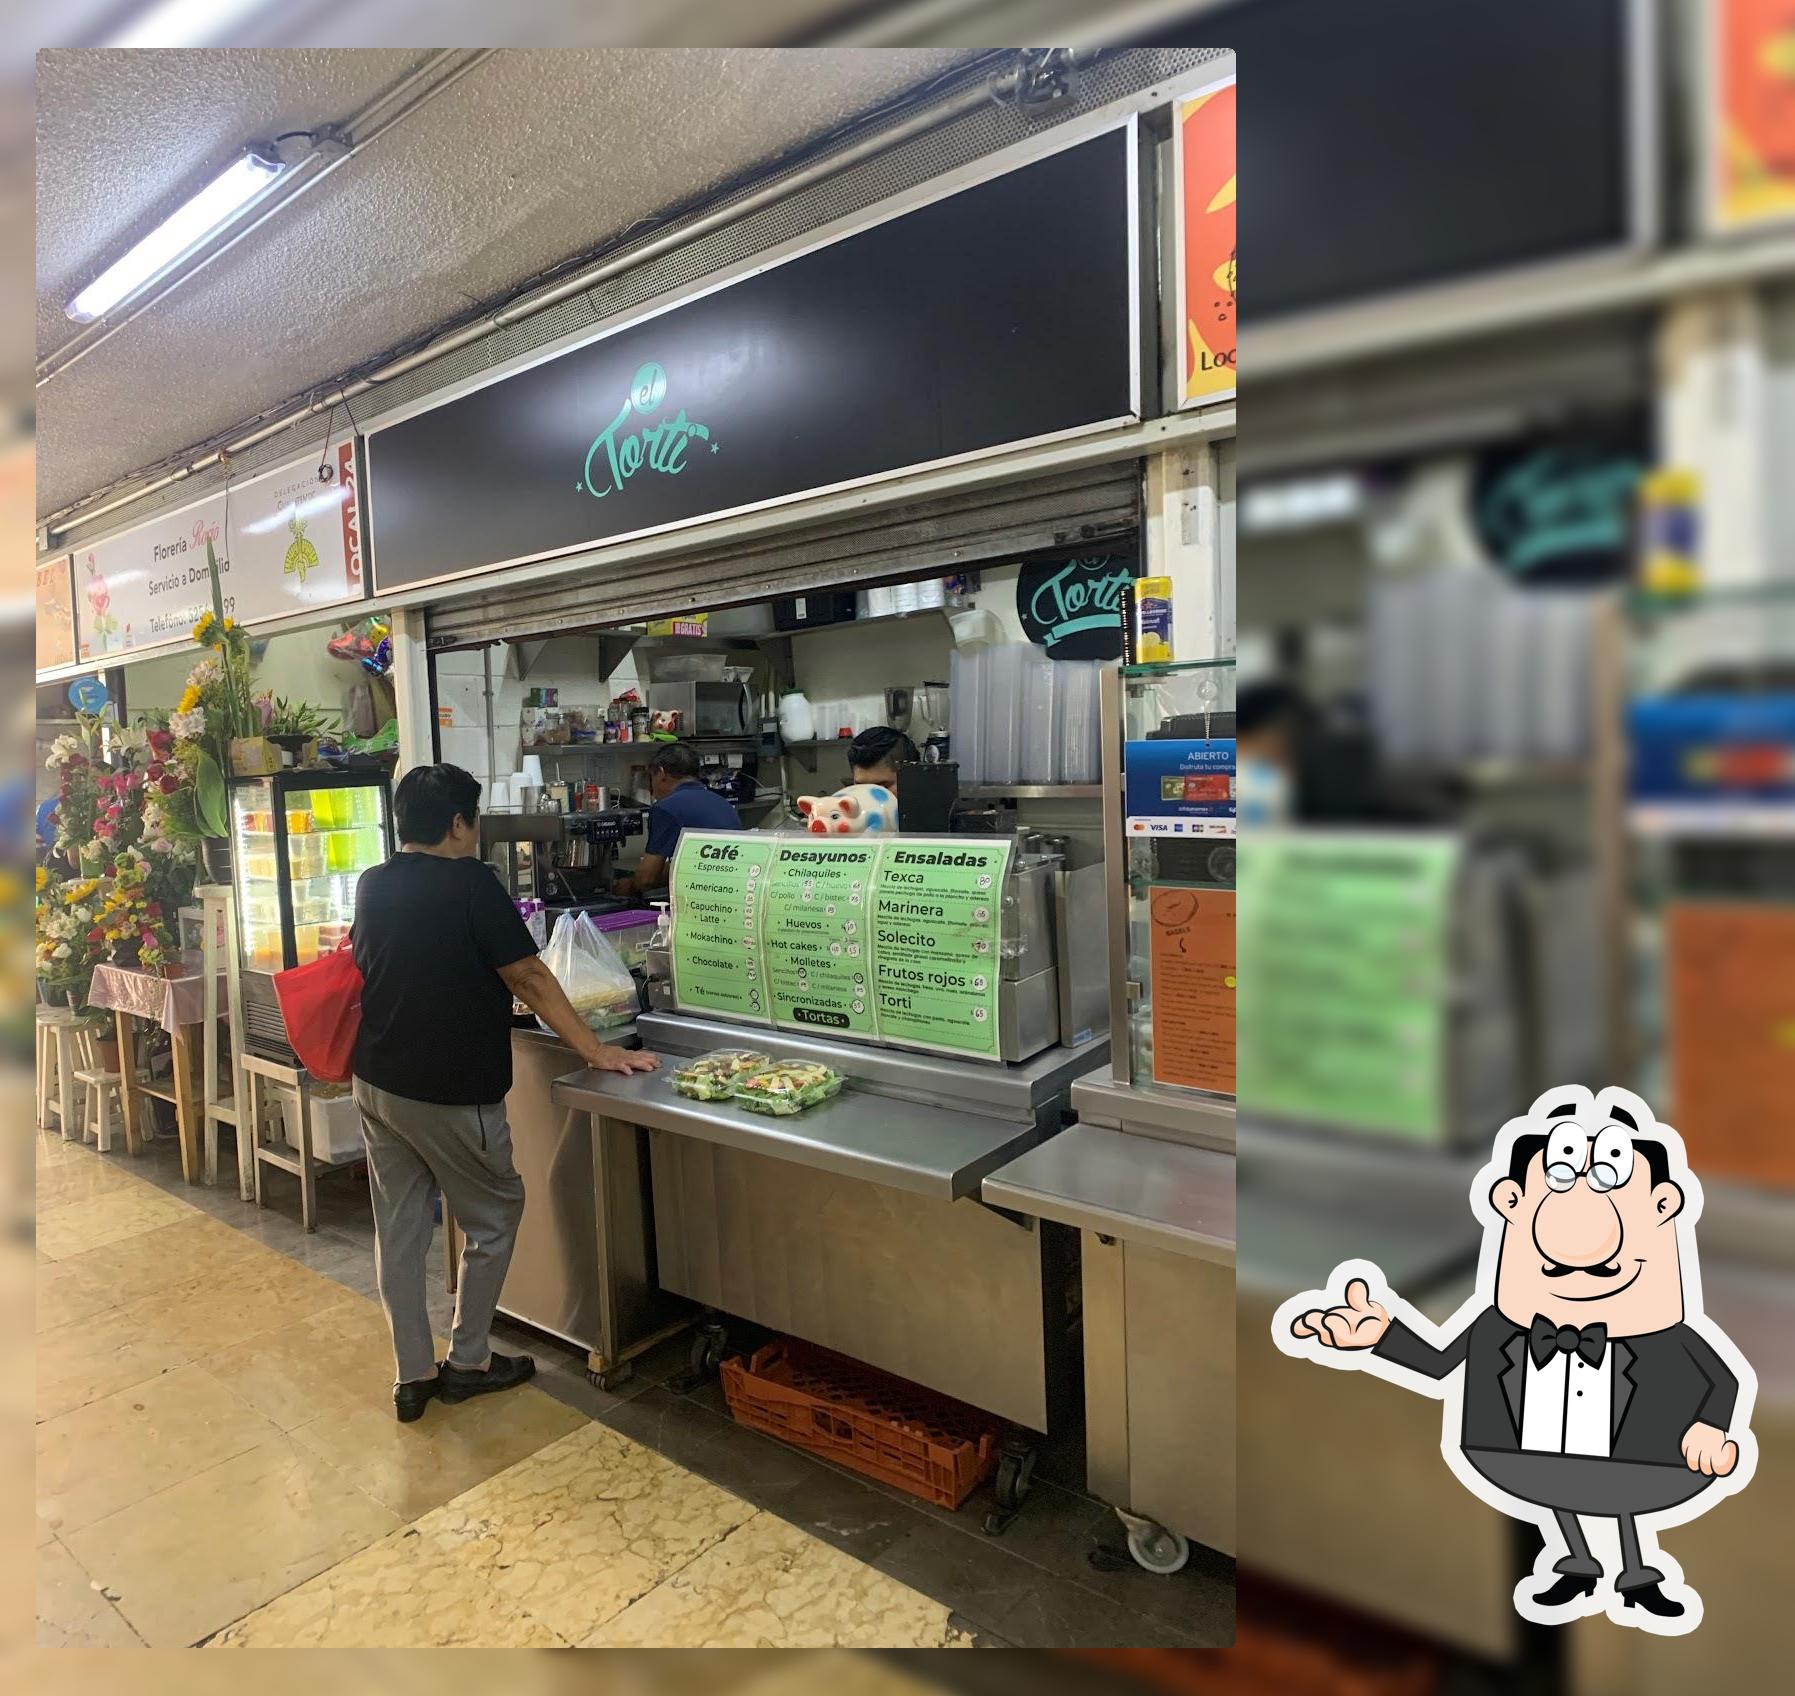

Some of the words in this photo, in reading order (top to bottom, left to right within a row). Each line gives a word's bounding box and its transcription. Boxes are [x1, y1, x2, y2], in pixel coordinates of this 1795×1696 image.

[585, 398, 690, 497] Torti
[154, 537, 187, 562] Florería
[148, 574, 179, 596] Servicio
[182, 576, 187, 585] a
[681, 623, 702, 635] GRATIS
[1188, 752, 1229, 760] ABIERTO
[700, 844, 740, 860] Café
[780, 850, 867, 864] Desayunos
[894, 851, 988, 868] Ensaladas
[698, 862, 734, 872] Espresso
[788, 868, 841, 879] Chilaquiles
[884, 870, 924, 884] Texca
[690, 882, 734, 894] Americano
[690, 901, 733, 914] Capuchino
[878, 900, 944, 917] Marinera
[700, 914, 720, 924] Latte
[786, 919, 822, 929] Huevos
[690, 932, 733, 944] Mokachino
[878, 930, 936, 948] Solecito
[771, 940, 788, 949] Hot
[790, 942, 818, 952] cakes
[692, 956, 734, 970] Chocolate
[790, 957, 831, 968] Molletes
[879, 964, 924, 982] Frutos
[928, 972, 966, 988] rojos
[695, 986, 705, 996] Té
[777, 992, 842, 1009] Sincronizadas
[880, 993, 912, 1009] Torti
[801, 1010, 840, 1025] Tortas
